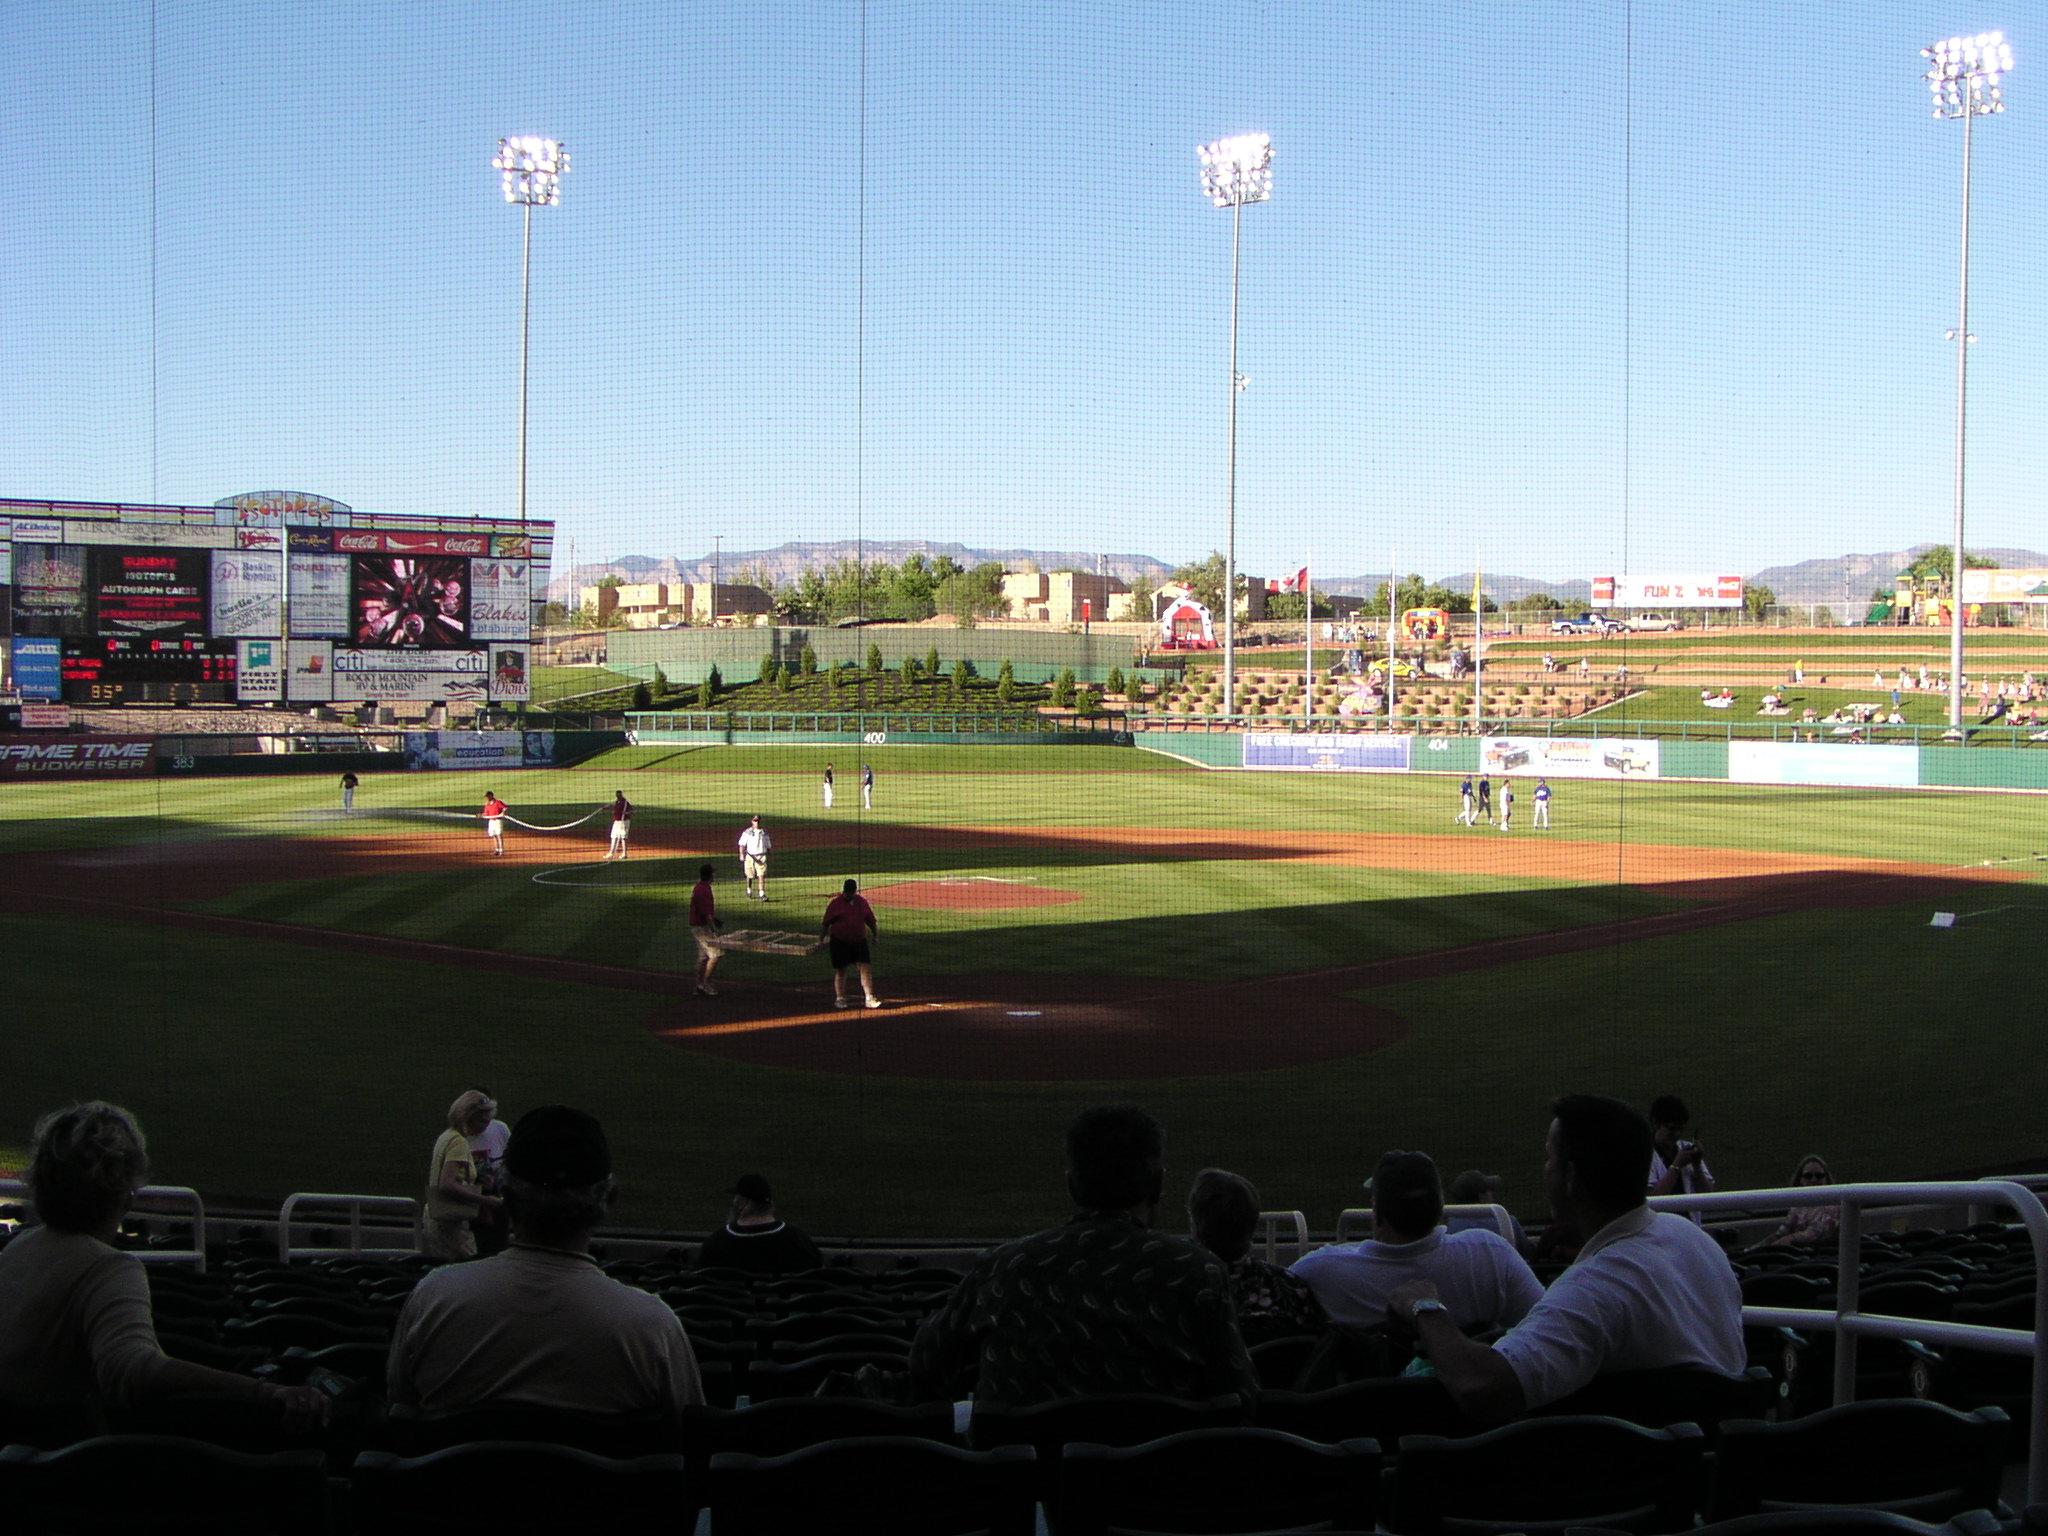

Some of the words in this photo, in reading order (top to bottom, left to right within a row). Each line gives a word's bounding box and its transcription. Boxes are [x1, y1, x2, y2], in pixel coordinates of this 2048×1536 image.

[335, 654, 364, 670] citi
[456, 656, 483, 671] citi
[379, 674, 428, 683] MOUNTAIN
[863, 732, 886, 744] 400
[81, 742, 153, 758] TIME
[1428, 739, 1448, 750] 404
[15, 759, 145, 772] BUDWEISER
[172, 757, 196, 769] 383
